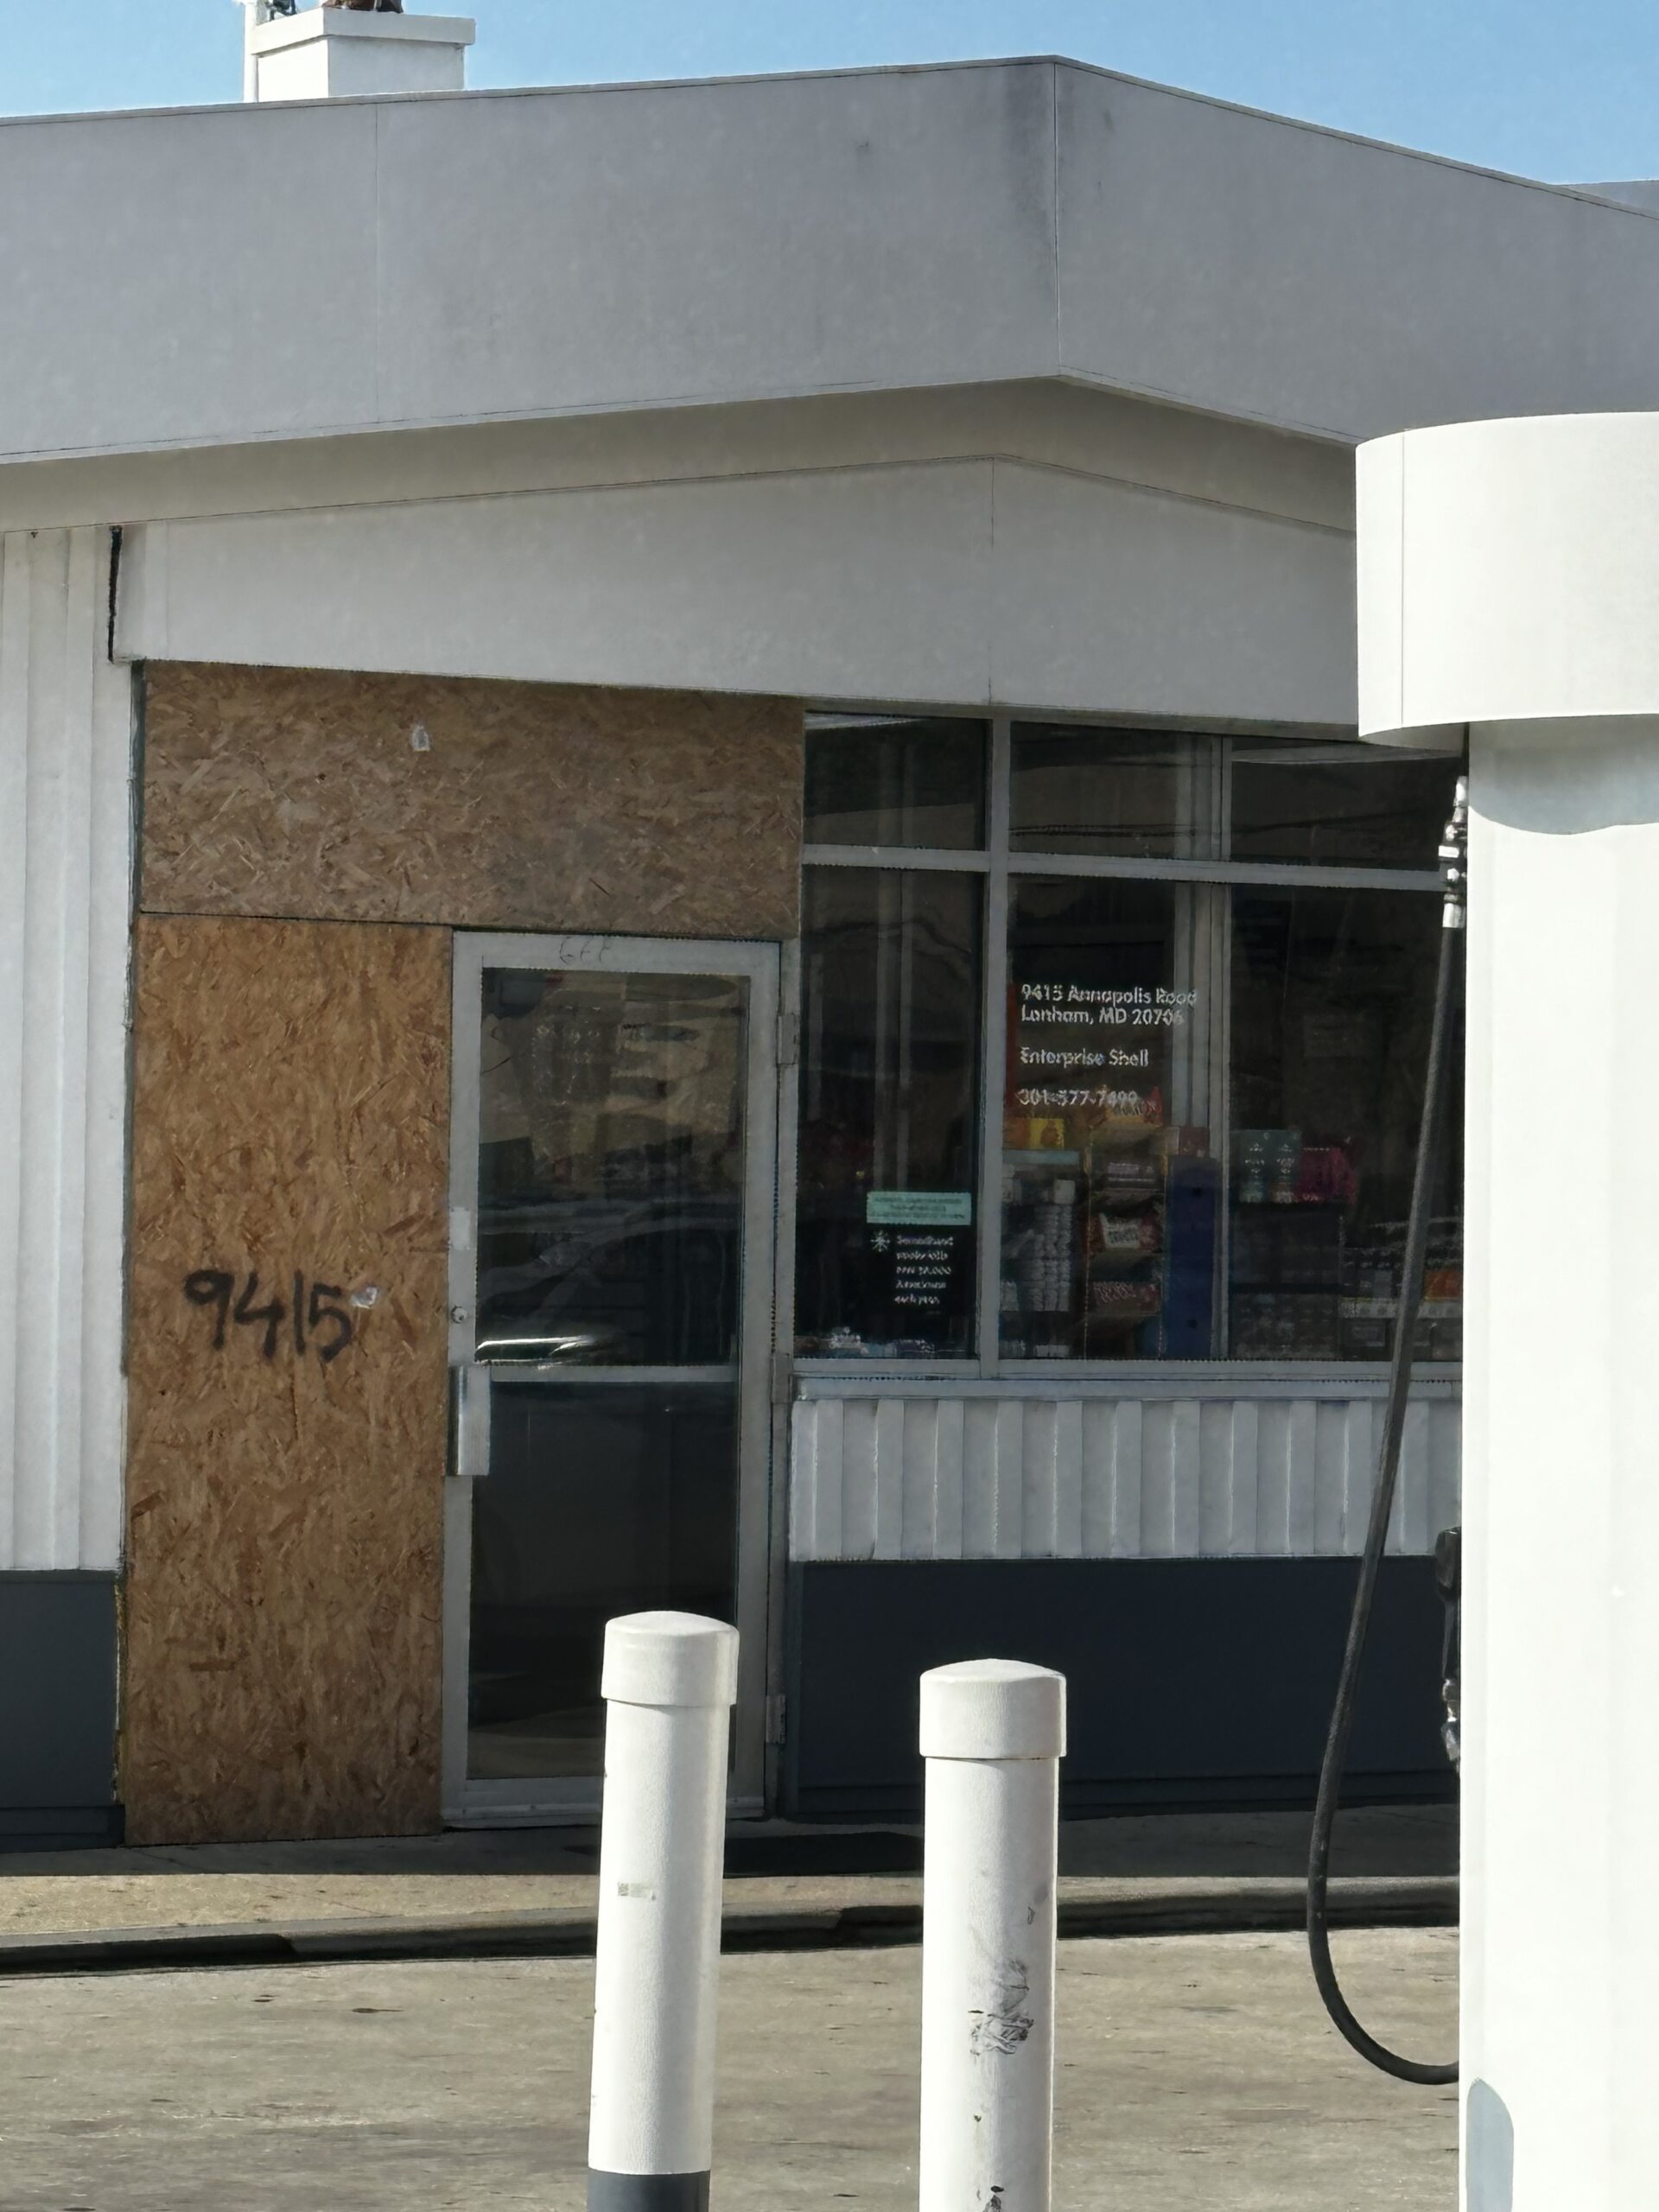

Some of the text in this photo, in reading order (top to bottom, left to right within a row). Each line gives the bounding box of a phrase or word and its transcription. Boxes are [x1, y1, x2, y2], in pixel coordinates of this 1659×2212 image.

[1021, 984, 1198, 1007] 9415 Annapolis Road
[1021, 1004, 1094, 1026] Lanham,
[1099, 1007, 1128, 1024] MD
[1020, 1046, 1149, 1068] Enterprise Shell
[182, 1268, 353, 1363] 9415
